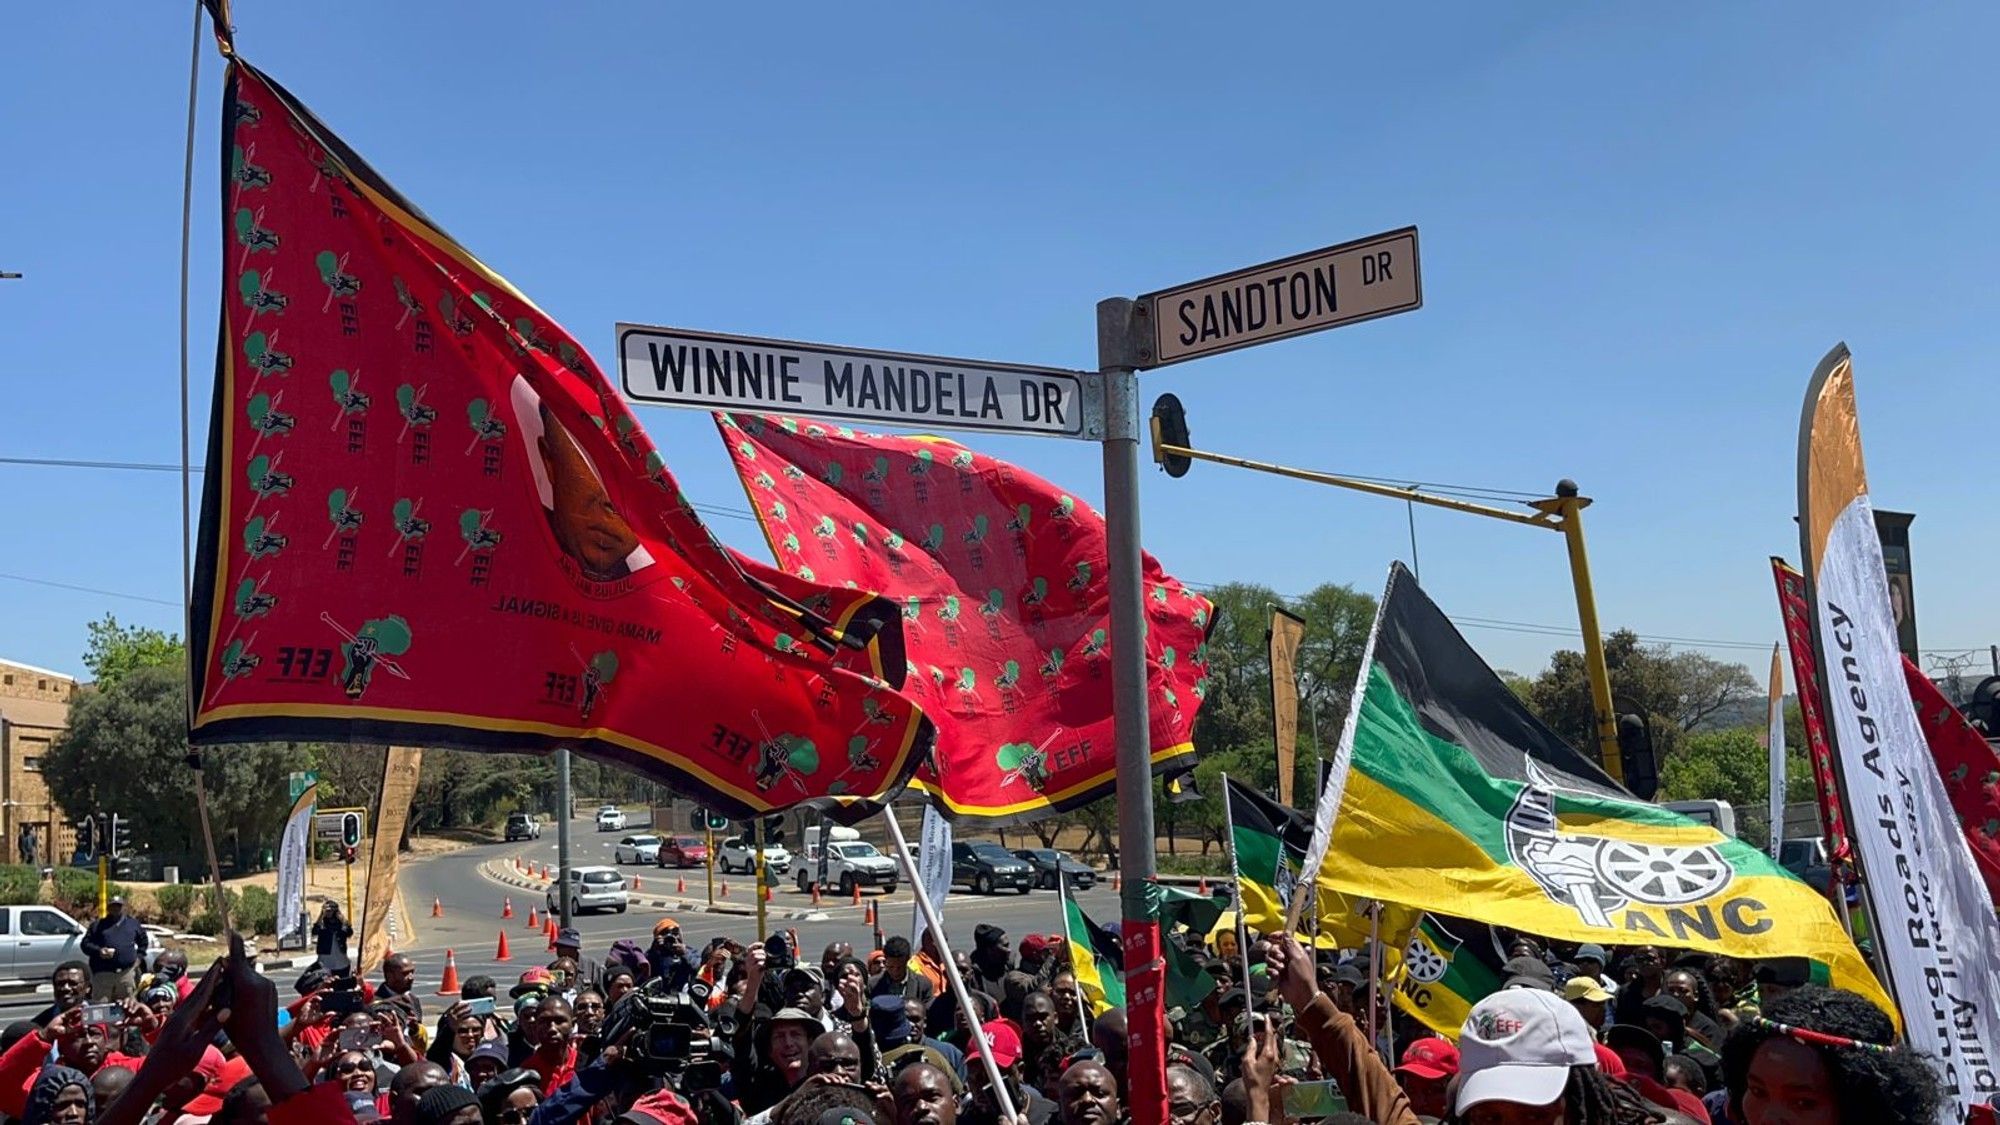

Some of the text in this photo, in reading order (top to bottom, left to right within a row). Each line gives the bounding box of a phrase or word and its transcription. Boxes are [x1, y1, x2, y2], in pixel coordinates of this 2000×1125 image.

[1179, 251, 1393, 346] SANDTON DR
[648, 342, 1065, 424] WINNIE MANDELA DR
[823, 542, 838, 562] EFF
[946, 625, 957, 647] EFF
[1003, 692, 1015, 715] EFF
[1828, 601, 1885, 780] Agency
[1054, 739, 1094, 770] EFF
[1878, 794, 1931, 948] Roads
[1625, 897, 1774, 941] ANC
[1397, 979, 1432, 1009] NC
[1496, 1019, 1522, 1033] EFF
[1947, 993, 2000, 1093] bility
